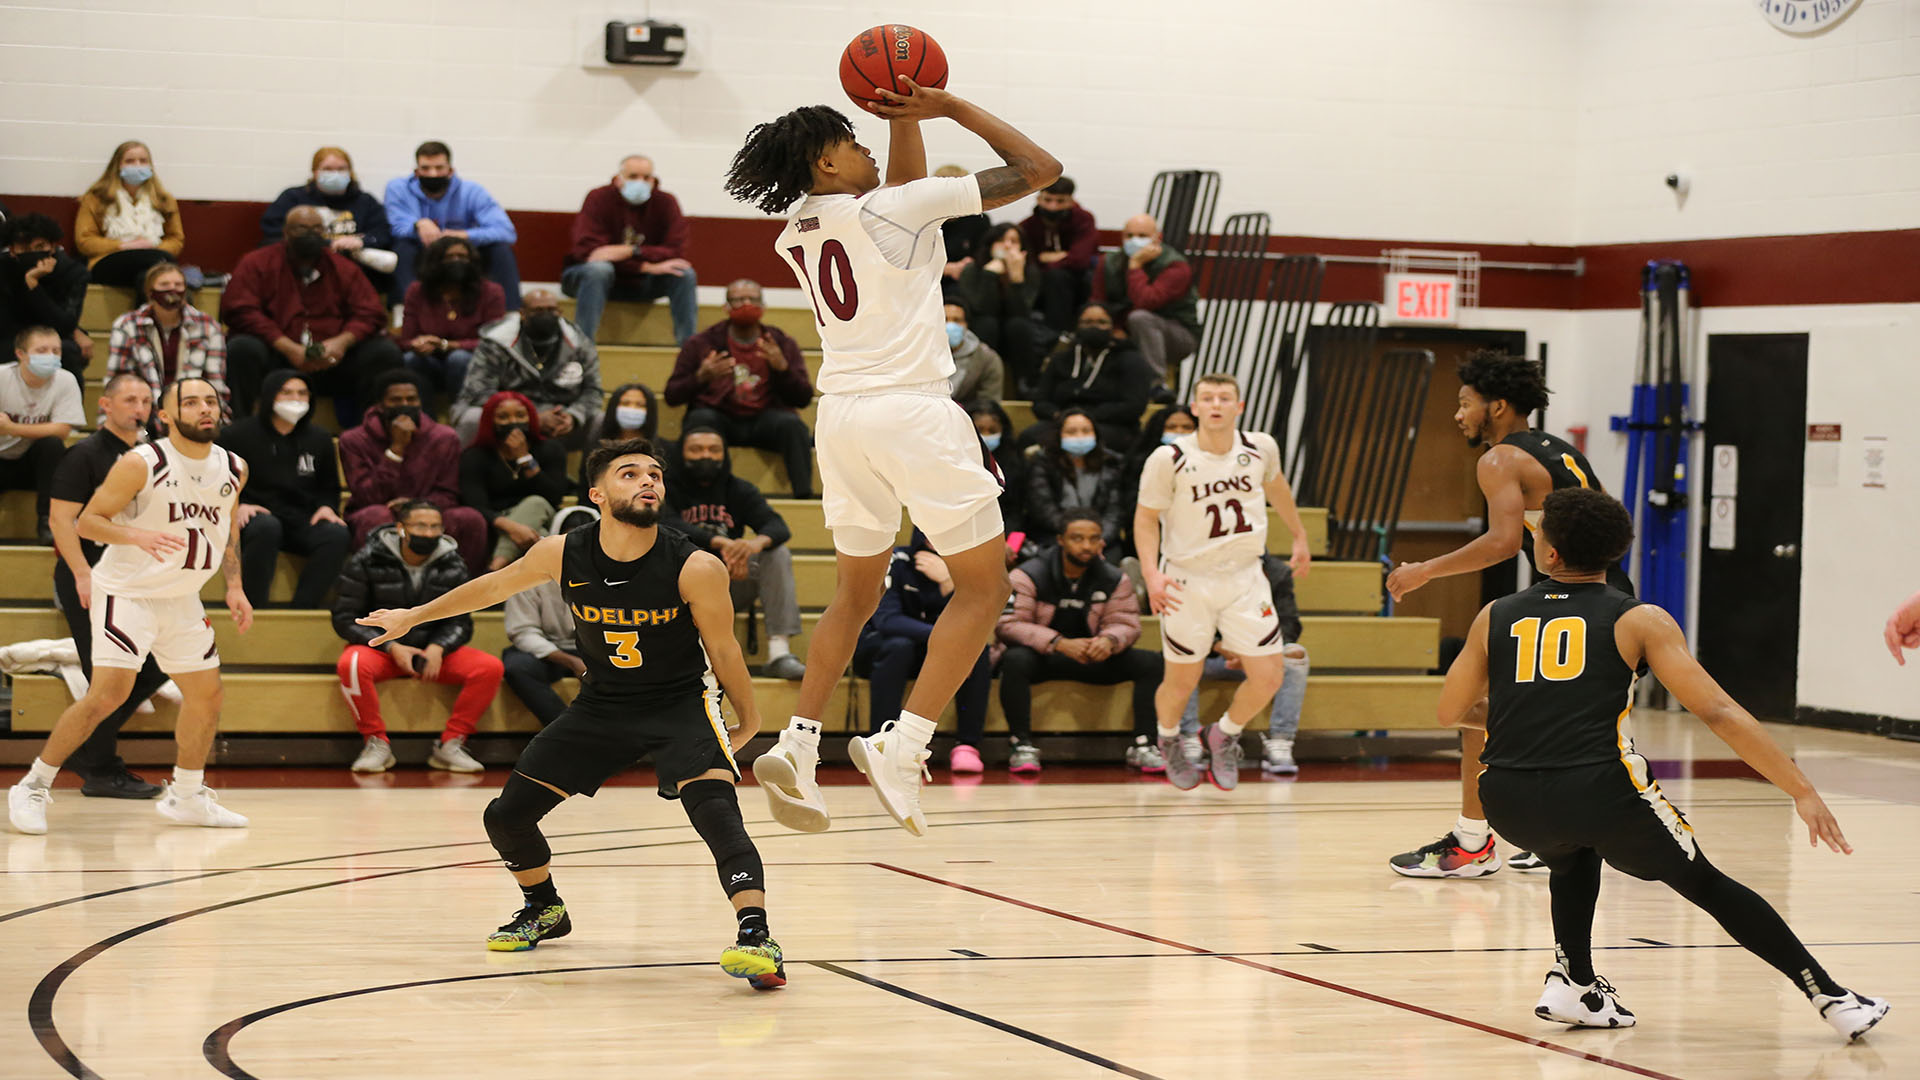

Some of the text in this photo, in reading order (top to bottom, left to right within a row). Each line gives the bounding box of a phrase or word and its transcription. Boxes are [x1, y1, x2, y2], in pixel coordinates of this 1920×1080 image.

[787, 238, 859, 327] 10
[1397, 281, 1452, 318] EXIT
[1191, 475, 1252, 503] LIONS
[168, 502, 220, 526] LIONS
[1205, 498, 1253, 539] 22
[181, 528, 212, 570] 11
[603, 631, 643, 669] 3
[1510, 616, 1587, 683] 10
